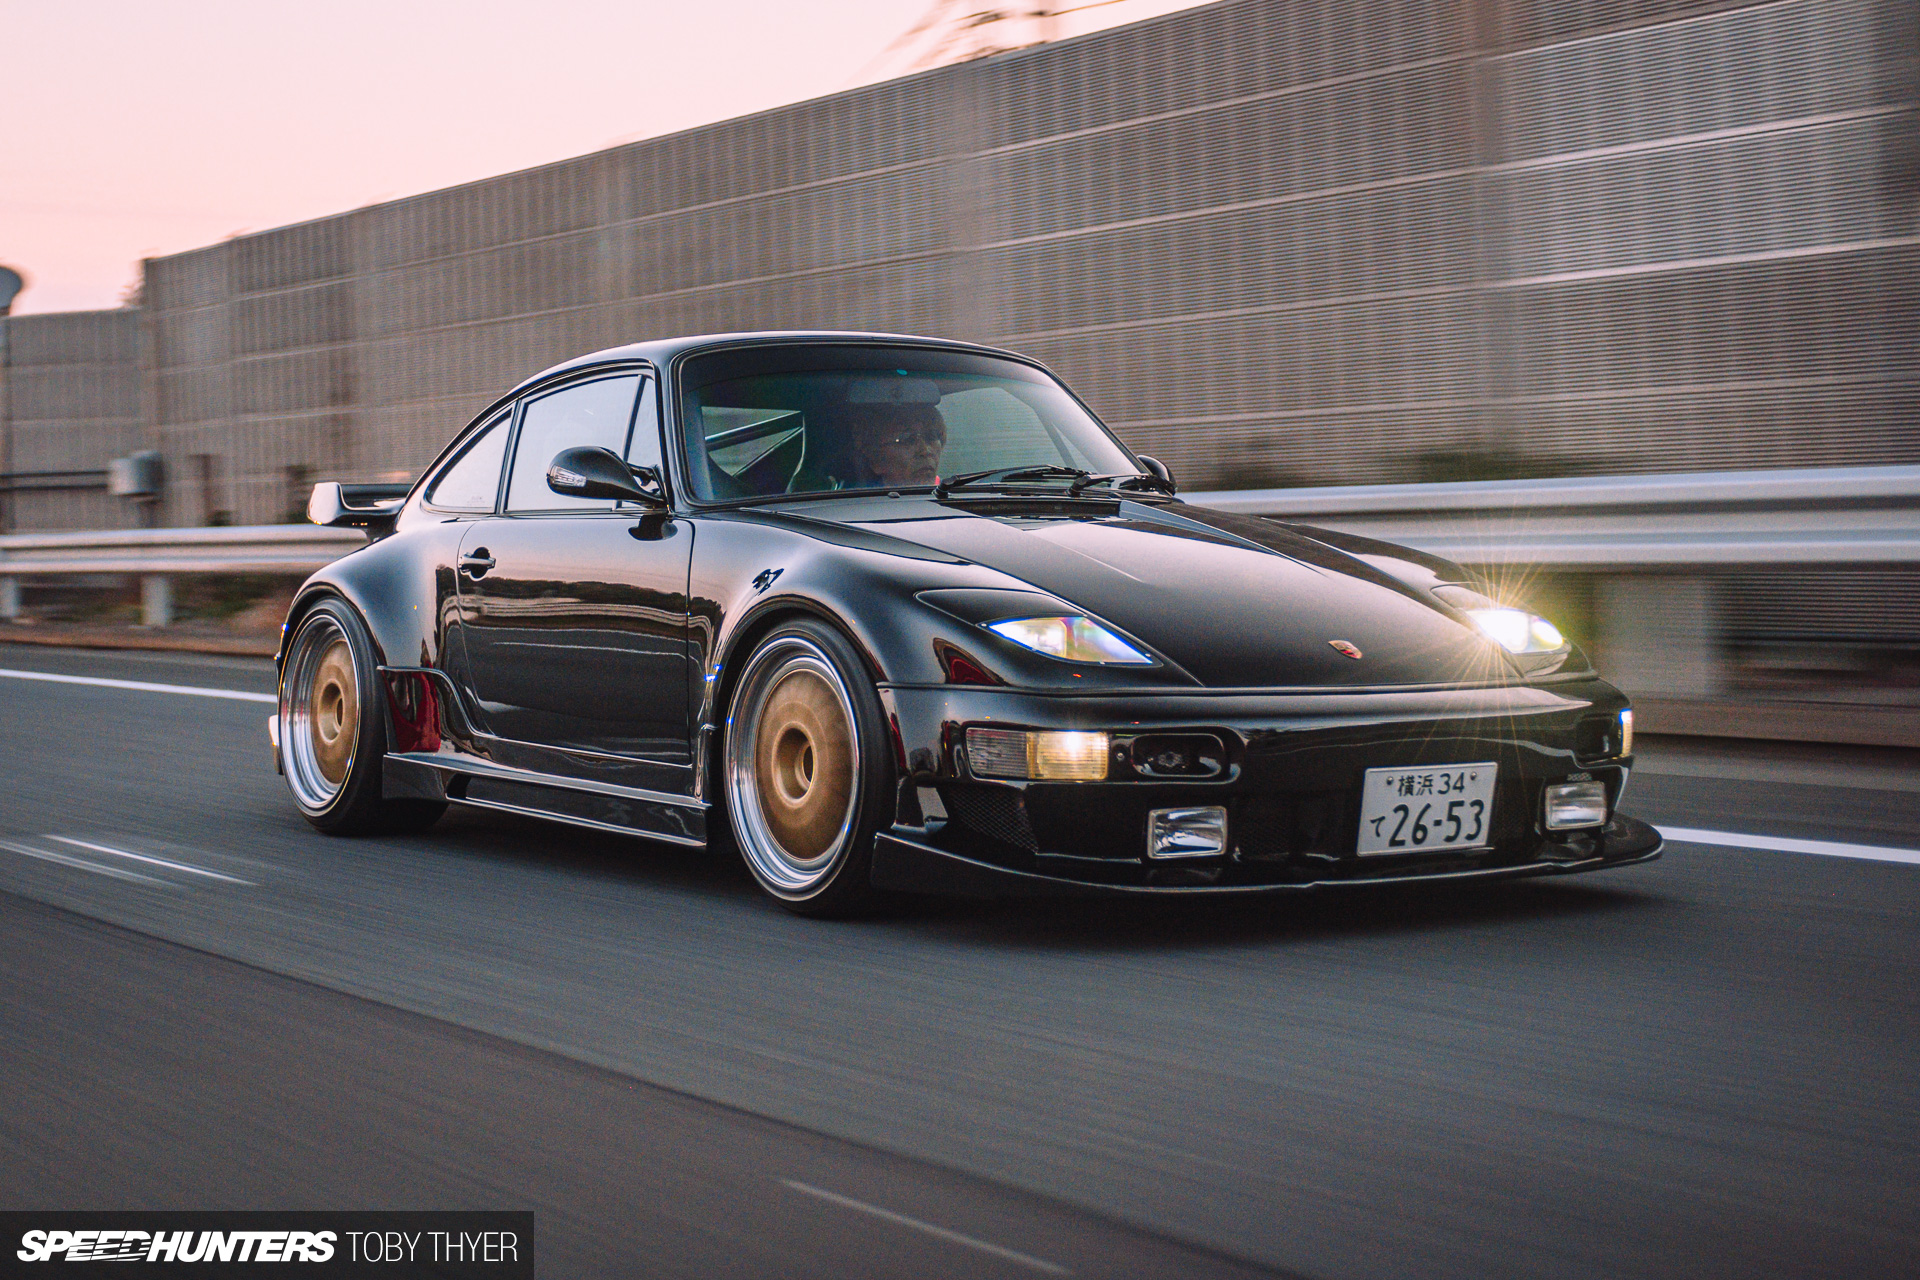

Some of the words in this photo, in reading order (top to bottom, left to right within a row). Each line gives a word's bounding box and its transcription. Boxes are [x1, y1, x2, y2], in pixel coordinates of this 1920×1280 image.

[1398, 774, 1433, 796] 横浜
[1438, 772, 1465, 795] 34
[1370, 816, 1386, 837] て
[1388, 799, 1485, 847] 26-53
